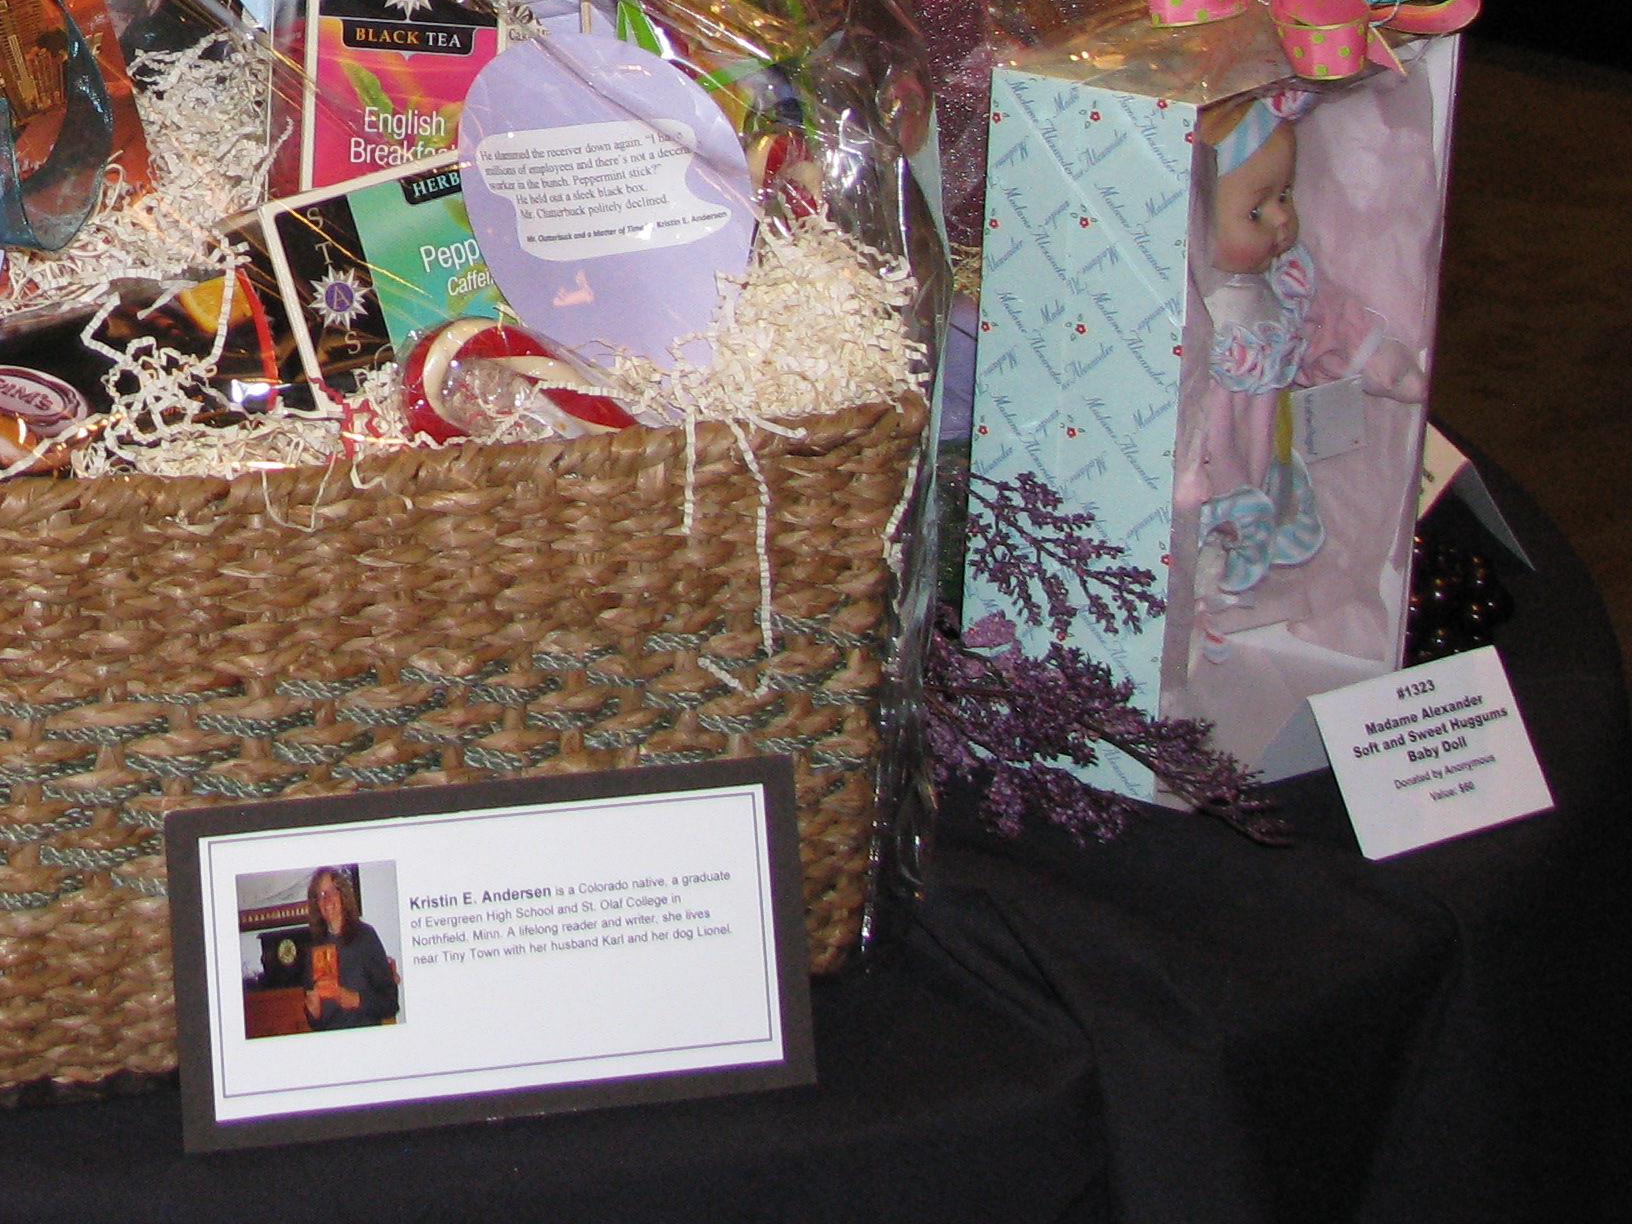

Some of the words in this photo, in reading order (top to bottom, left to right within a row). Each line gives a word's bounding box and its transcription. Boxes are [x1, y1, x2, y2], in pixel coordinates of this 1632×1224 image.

[355, 27, 419, 44] BLACK
[426, 32, 462, 48] TEA
[364, 107, 445, 139] English
[350, 138, 458, 166] Breakf
[480, 151, 492, 161] He
[532, 149, 544, 158] the
[547, 146, 582, 158] receiver
[585, 143, 611, 153] down
[614, 138, 643, 151] again.
[1095, 184, 1130, 229] Madame
[1131, 224, 1171, 280] Alexander
[1397, 679, 1436, 700] #1323
[1365, 714, 1417, 735] Madame
[1422, 693, 1483, 720] Alexander
[1353, 742, 1380, 758] Soft
[1383, 736, 1406, 750] and
[1409, 725, 1448, 743] Sweet
[1450, 707, 1508, 731] Huggums
[1407, 745, 1439, 762] Baby
[1443, 737, 1468, 753] Doll
[1394, 770, 1431, 789] Donated
[1433, 767, 1444, 779] by
[1445, 754, 1495, 774] Anonymous
[409, 894, 458, 911] Kristin
[463, 891, 478, 905] E.
[482, 885, 552, 904] Andersen
[555, 885, 564, 896] is
[567, 886, 575, 895] a
[578, 880, 628, 895] Colorado
[632, 877, 668, 890] native,
[671, 876, 679, 885] a
[682, 870, 731, 887] graduate
[411, 917, 422, 929] of
[426, 912, 483, 930] Evergreen
[487, 909, 512, 923] High
[516, 904, 554, 919] School
[558, 902, 578, 915] and
[582, 900, 596, 912] St.
[600, 897, 624, 910] Olaf
[627, 895, 668, 909] College
[671, 892, 682, 904] in
[413, 953, 438, 966] near
[443, 950, 465, 965] Tiny
[470, 946, 501, 961] Town
[503, 944, 526, 957] with
[529, 942, 547, 954] her
[551, 936, 598, 953] husband
[602, 934, 624, 947] Karl
[628, 931, 648, 944] and
[651, 930, 669, 942] her
[672, 927, 693, 943] dog
[697, 923, 733, 938] Lionel.
